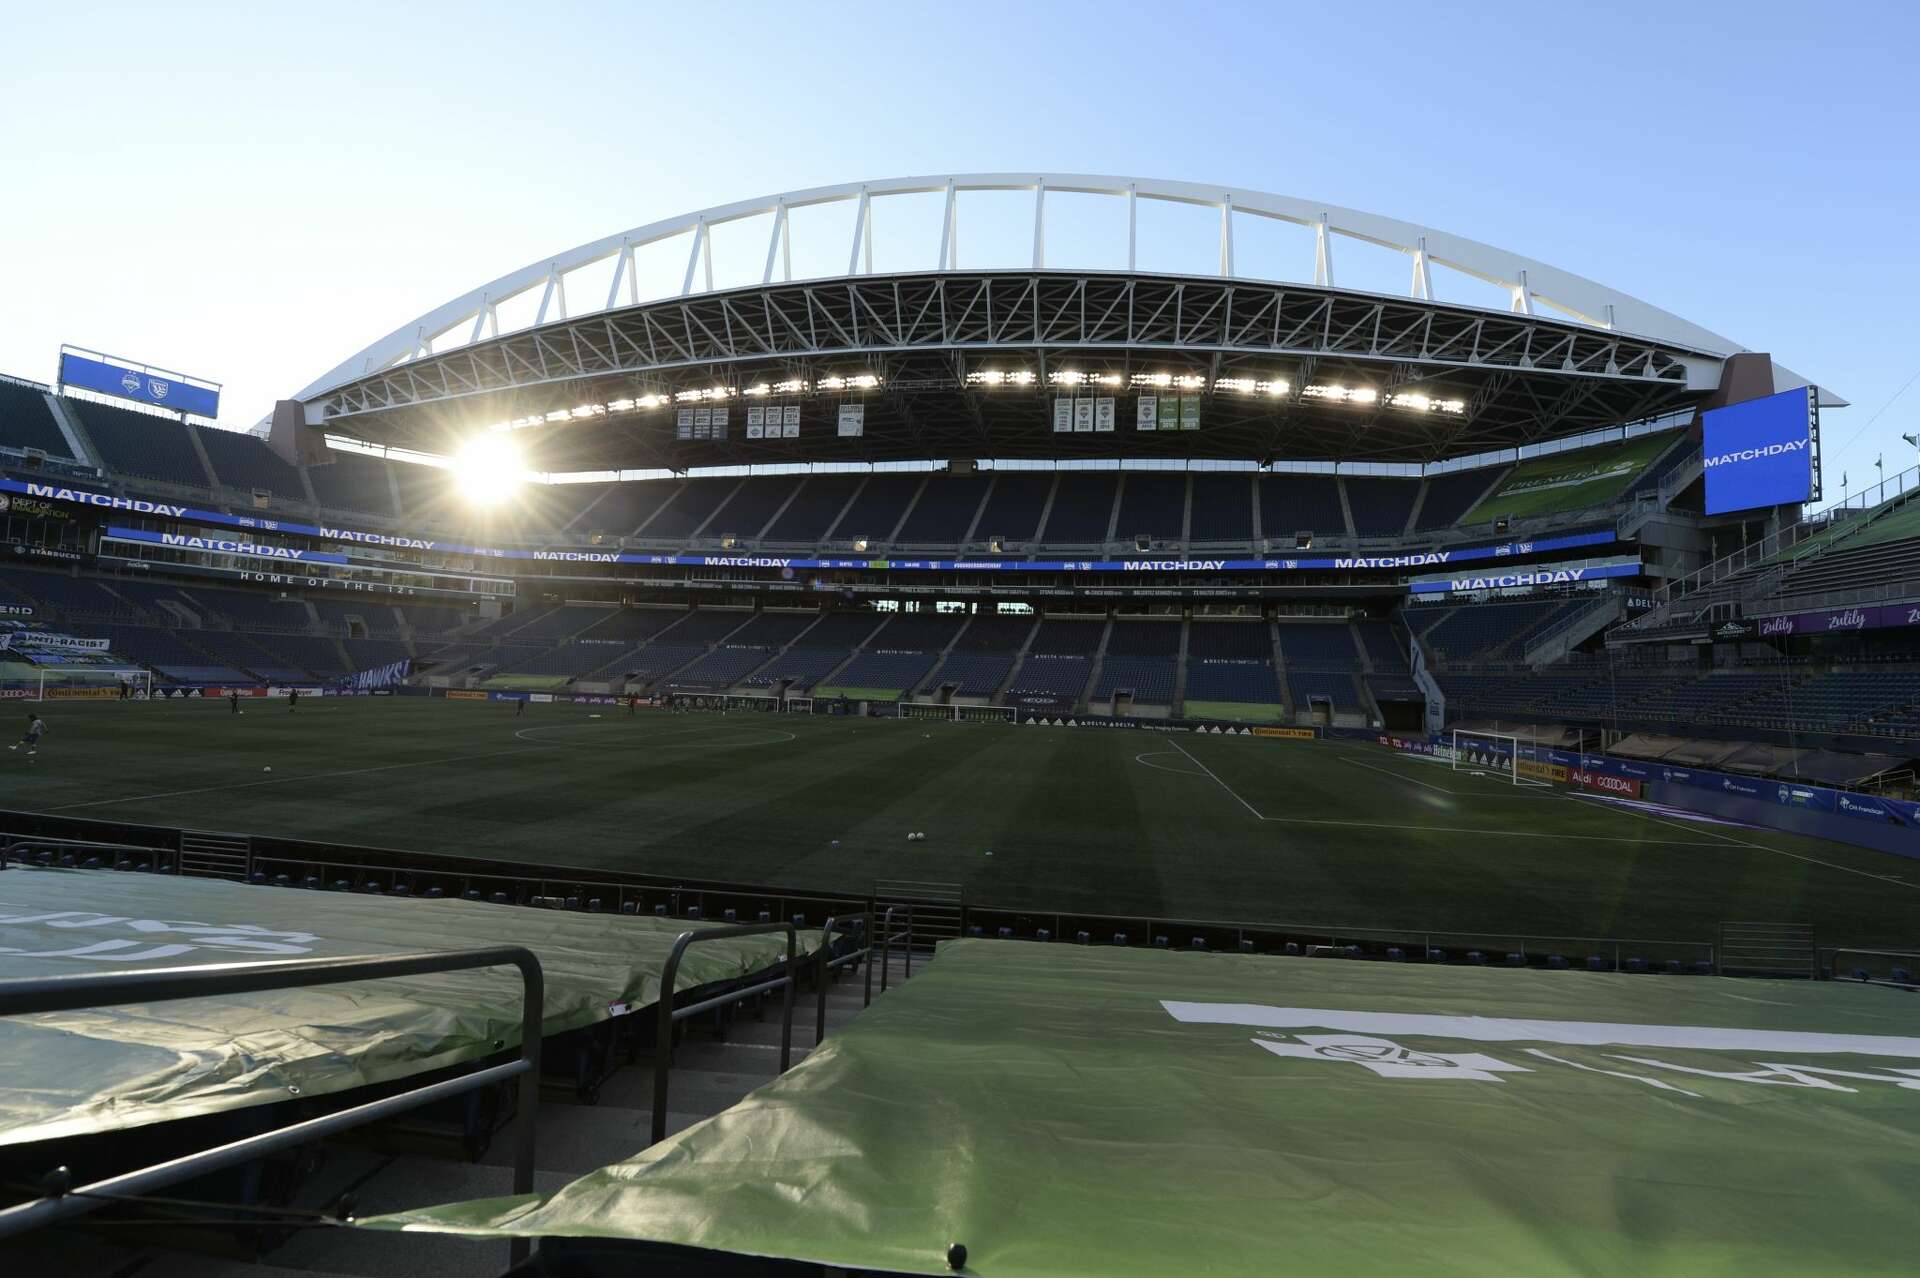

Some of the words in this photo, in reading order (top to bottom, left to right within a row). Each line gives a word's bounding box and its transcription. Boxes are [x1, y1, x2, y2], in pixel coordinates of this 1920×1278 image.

[1704, 439, 1808, 469] MATCHDAY
[27, 483, 187, 517] MATCHDAY
[162, 533, 302, 559] MATCHDAY
[319, 527, 435, 550] MATCHDAY
[30, 548, 81, 560] STARBUCKS
[533, 551, 620, 563] MATCHDAY
[705, 556, 791, 568] MATCHDAY
[1334, 551, 1450, 568] MATCHDAY
[1123, 561, 1226, 571] MATCHDAY
[240, 572, 295, 584] HOME
[308, 578, 329, 587] OF
[344, 582, 376, 591] THE
[1451, 569, 1585, 591] MATCHDAY
[1635, 598, 1663, 609] DELTA
[1572, 771, 1592, 784] Audi
